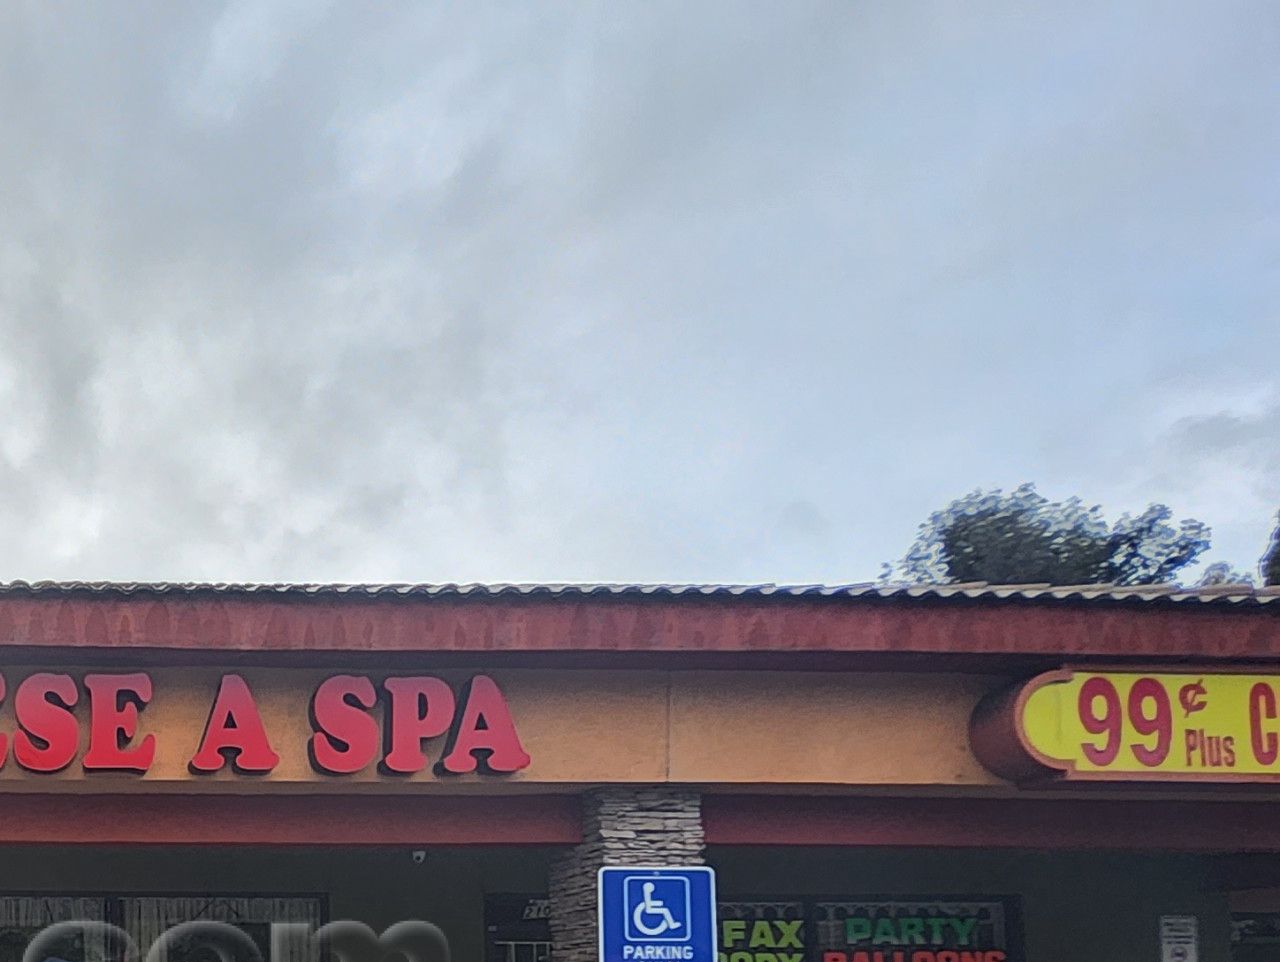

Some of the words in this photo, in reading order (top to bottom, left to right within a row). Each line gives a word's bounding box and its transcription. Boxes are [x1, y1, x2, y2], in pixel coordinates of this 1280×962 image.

[191, 673, 280, 772] A
[312, 674, 531, 774] SPA
[723, 920, 804, 948] FAX
[845, 917, 977, 945] PARTY
[623, 945, 694, 959] PARKING
